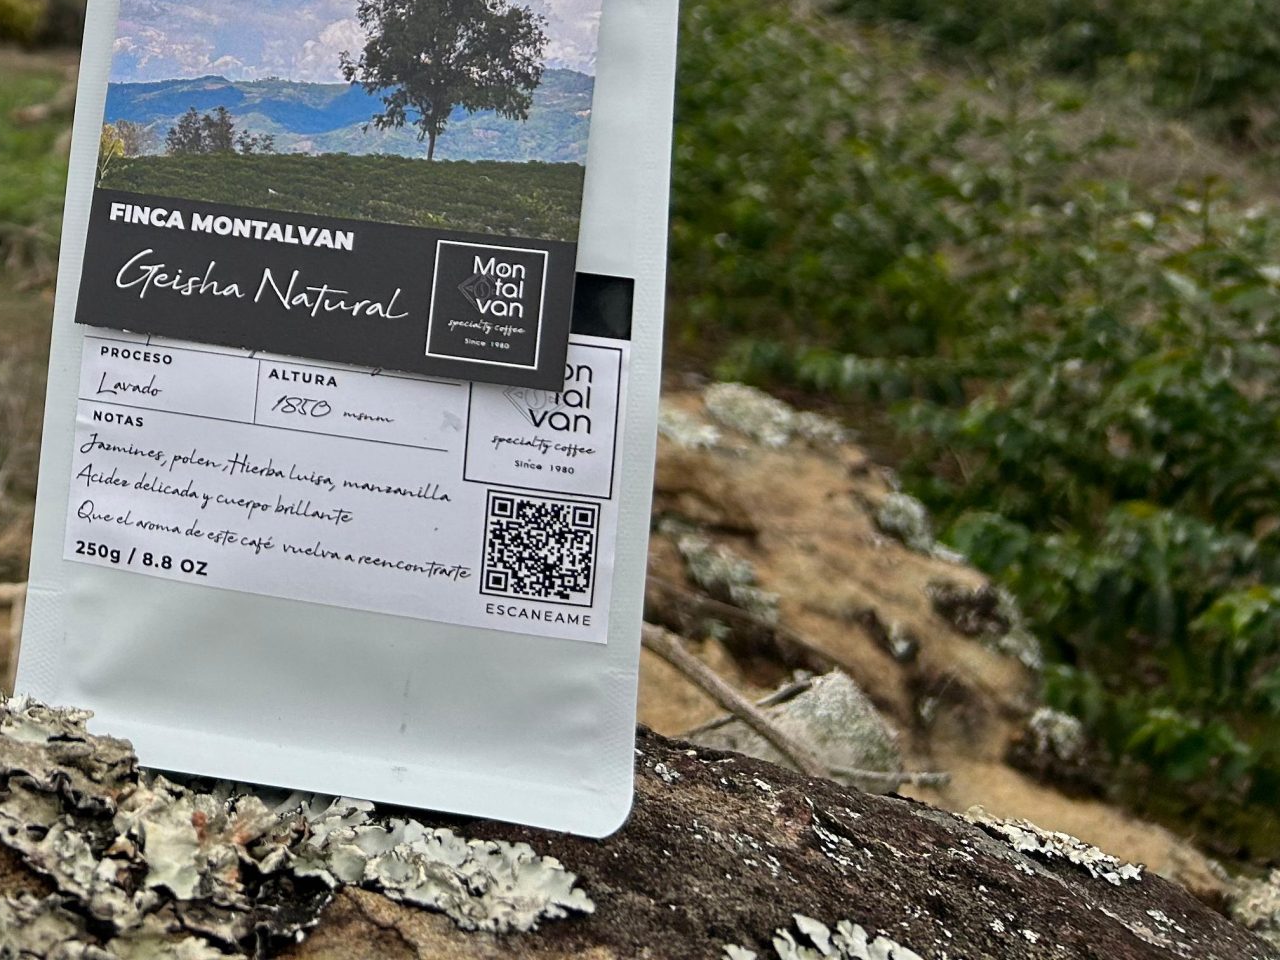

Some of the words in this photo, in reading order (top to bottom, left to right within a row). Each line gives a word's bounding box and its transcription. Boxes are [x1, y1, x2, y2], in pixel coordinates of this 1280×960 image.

[109, 202, 185, 230] FINCA
[191, 212, 354, 251] MONTALVAN
[473, 255, 526, 279] Mon
[115, 248, 245, 299] Geisha
[253, 267, 409, 319] Natural
[495, 278, 524, 298] tal
[476, 298, 523, 318] van
[447, 319, 493, 334] specialty
[494, 324, 526, 337] coffee
[100, 346, 173, 365] PROCESO
[490, 341, 510, 350] 1980
[96, 372, 163, 397] Lavado
[269, 368, 338, 387] ALTURA
[271, 395, 332, 417] 1850
[93, 410, 144, 427] NOTAS
[528, 409, 592, 434] van
[491, 435, 552, 455] specialty
[554, 443, 596, 458] coffee
[550, 464, 575, 475] 1980
[76, 463, 129, 487] Acidez
[134, 472, 199, 499] delicada
[202, 494, 213, 510] y
[216, 493, 271, 520] cuerpo
[274, 495, 353, 526] brillante
[343, 479, 452, 503] manzanilla
[77, 500, 114, 524] Que
[116, 510, 133, 526] el
[136, 520, 181, 534] aroma
[185, 519, 205, 538] de
[207, 530, 239, 546] este
[240, 536, 275, 555] café
[282, 541, 341, 561] vuelva
[344, 554, 356, 562] a
[357, 555, 472, 583] reencontrarte
[75, 540, 121, 564] 250g
[126, 547, 137, 565] /
[142, 552, 173, 570] 8.8
[180, 558, 209, 577] OZ
[485, 603, 592, 627] ESCANEAME
